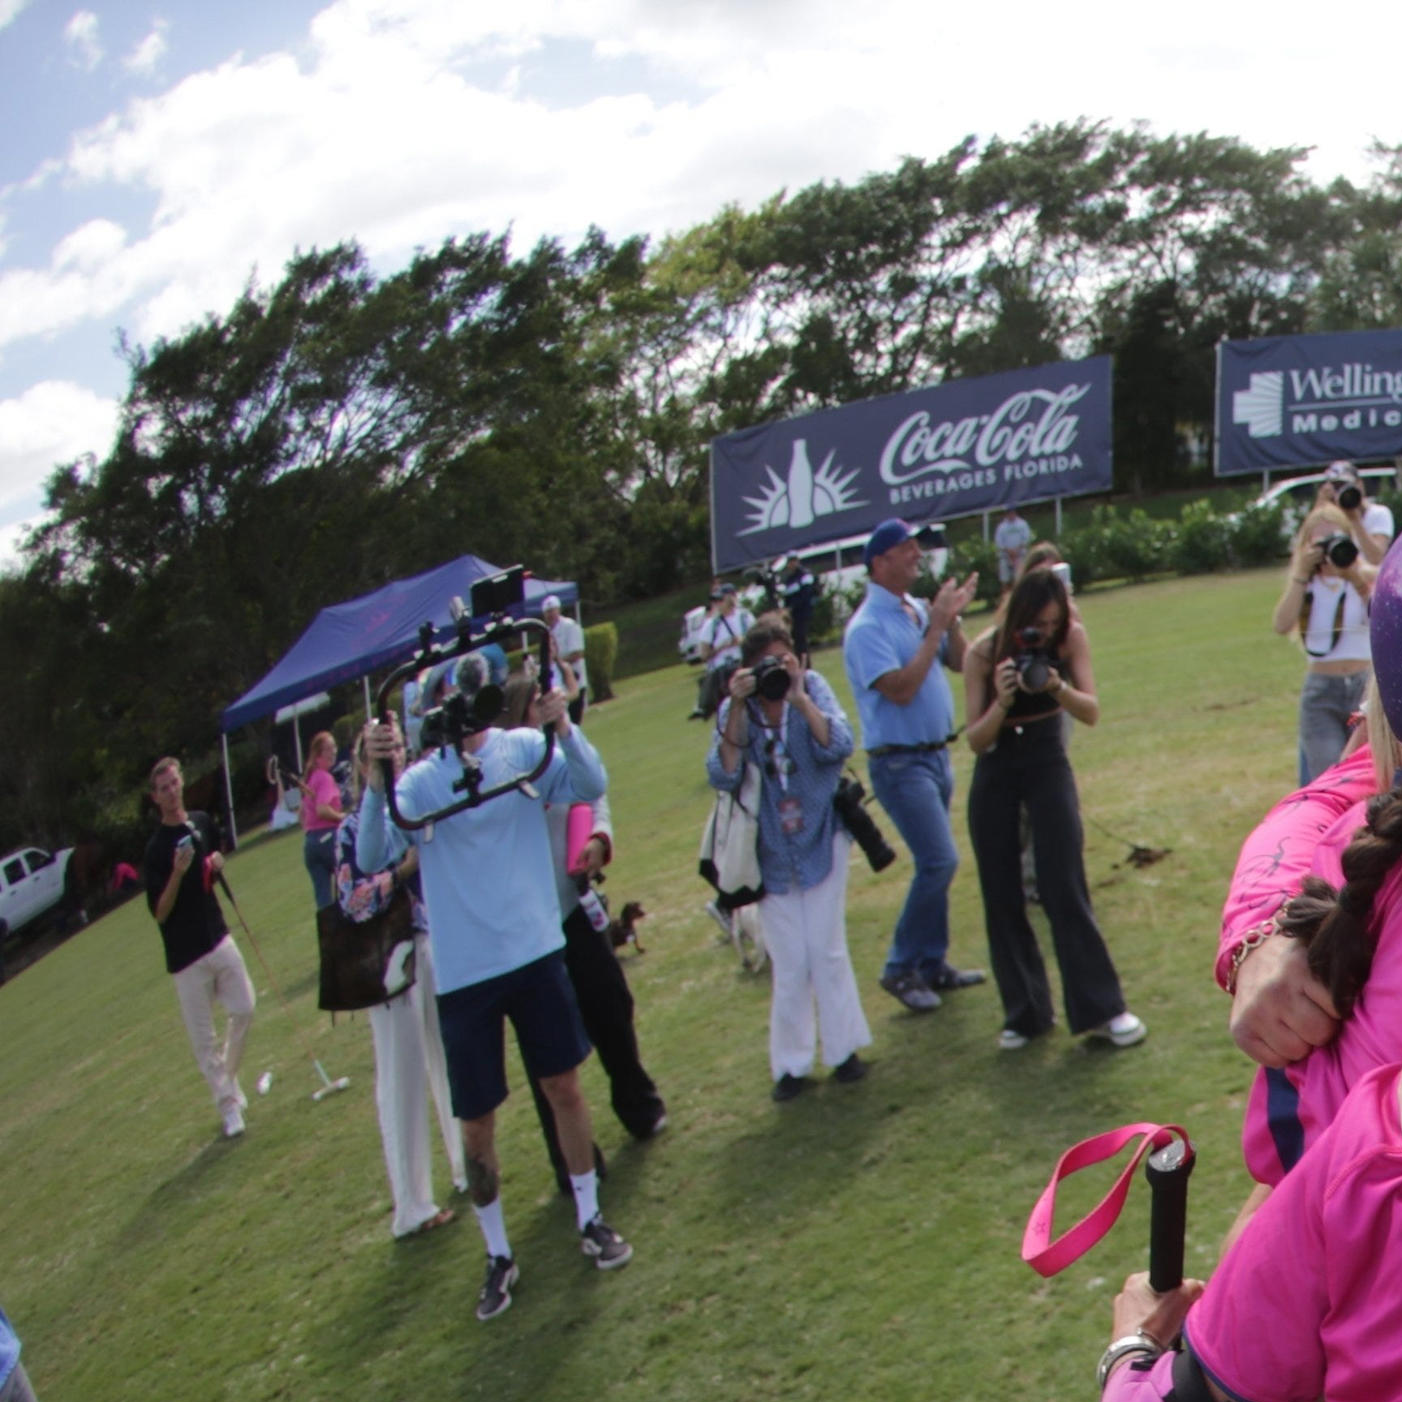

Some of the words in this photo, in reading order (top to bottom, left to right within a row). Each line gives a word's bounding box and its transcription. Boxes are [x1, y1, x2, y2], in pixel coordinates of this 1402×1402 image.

[879, 382, 1092, 485] Coca-Cola
[889, 468, 997, 505] BEVERAGES
[1004, 453, 1083, 482] FLORIDA
